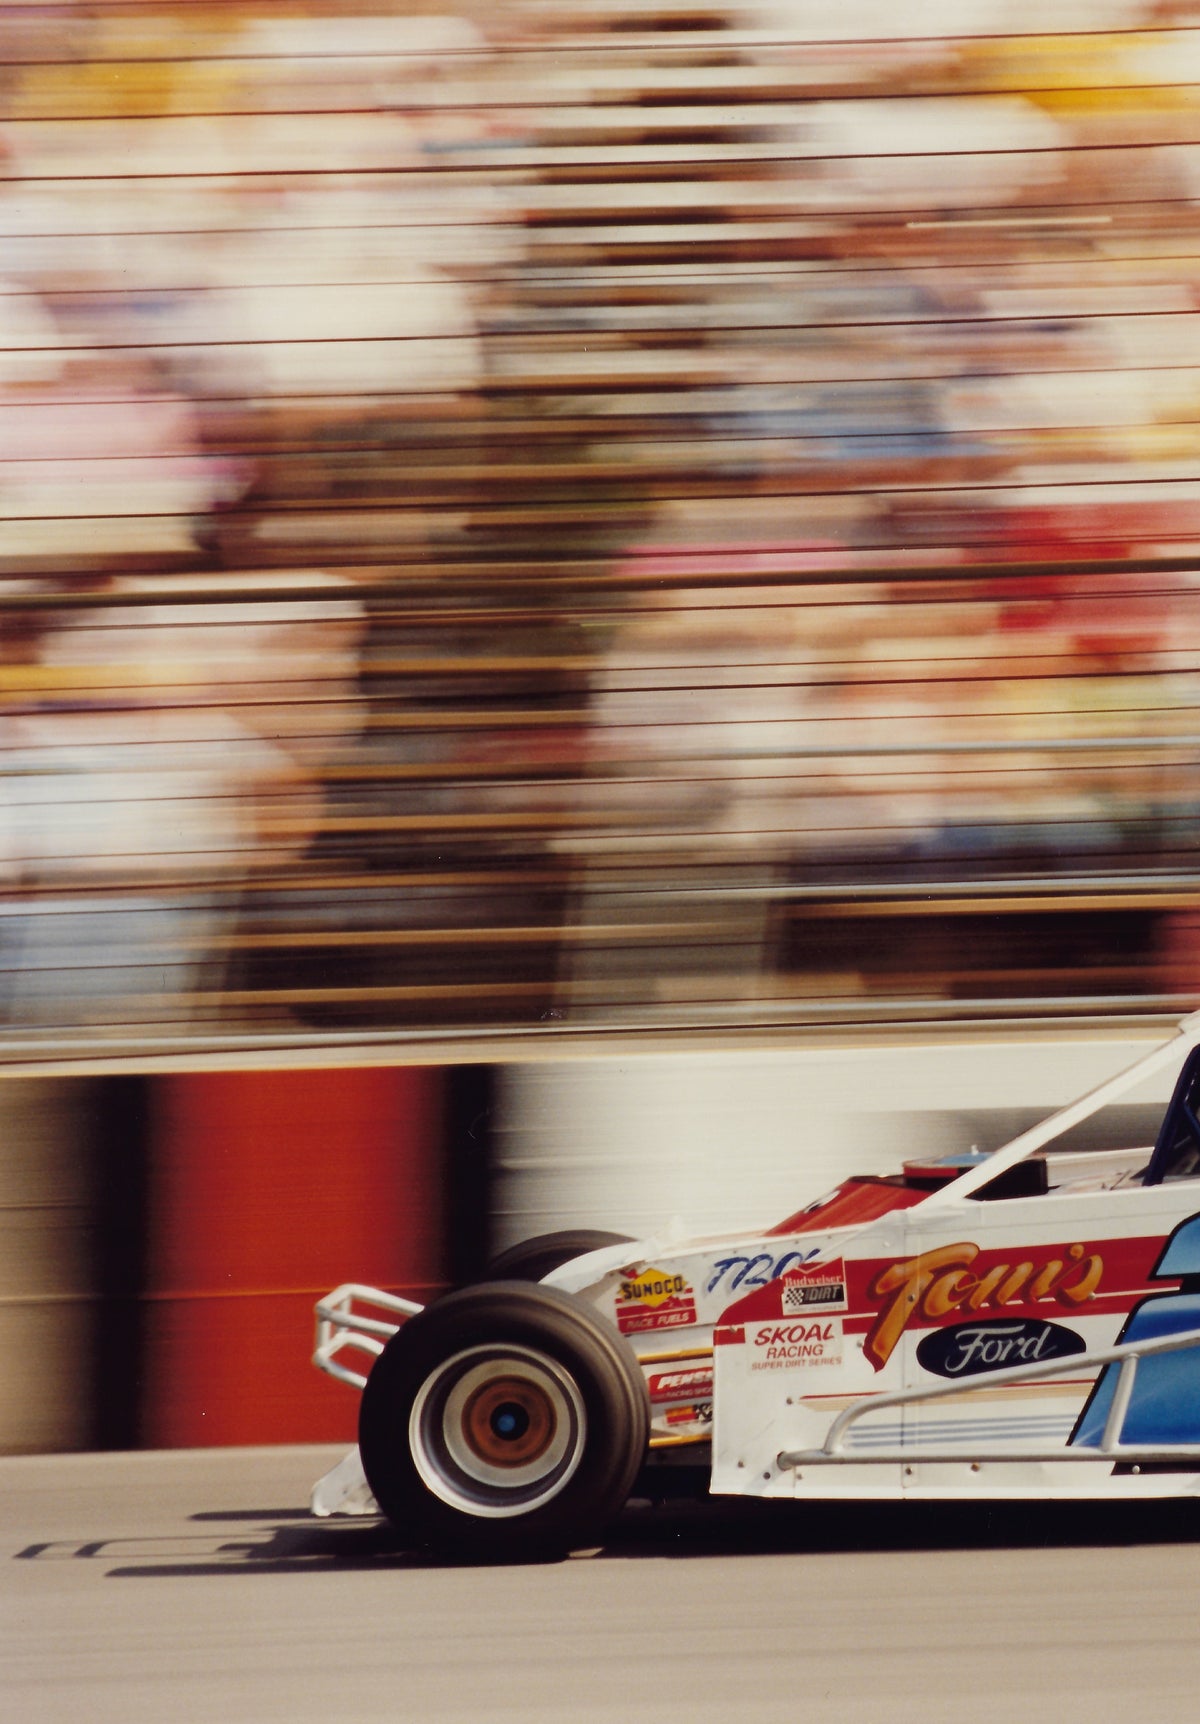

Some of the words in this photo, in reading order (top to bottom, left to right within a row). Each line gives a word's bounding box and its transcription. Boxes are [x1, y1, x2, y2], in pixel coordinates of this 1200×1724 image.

[621, 1275, 683, 1300] SUNOCO
[785, 1274, 842, 1287] Budweiser
[808, 1286, 840, 1301] DIRT
[864, 1241, 1104, 1372] Tom's
[657, 1312, 689, 1325] FUELS
[754, 1323, 835, 1346] SKOAL
[766, 1344, 824, 1359] RACING
[944, 1324, 1058, 1373] Ford
[751, 1362, 783, 1371] SUPER
[785, 1360, 806, 1368] DIRT
[808, 1356, 842, 1367] SERIES
